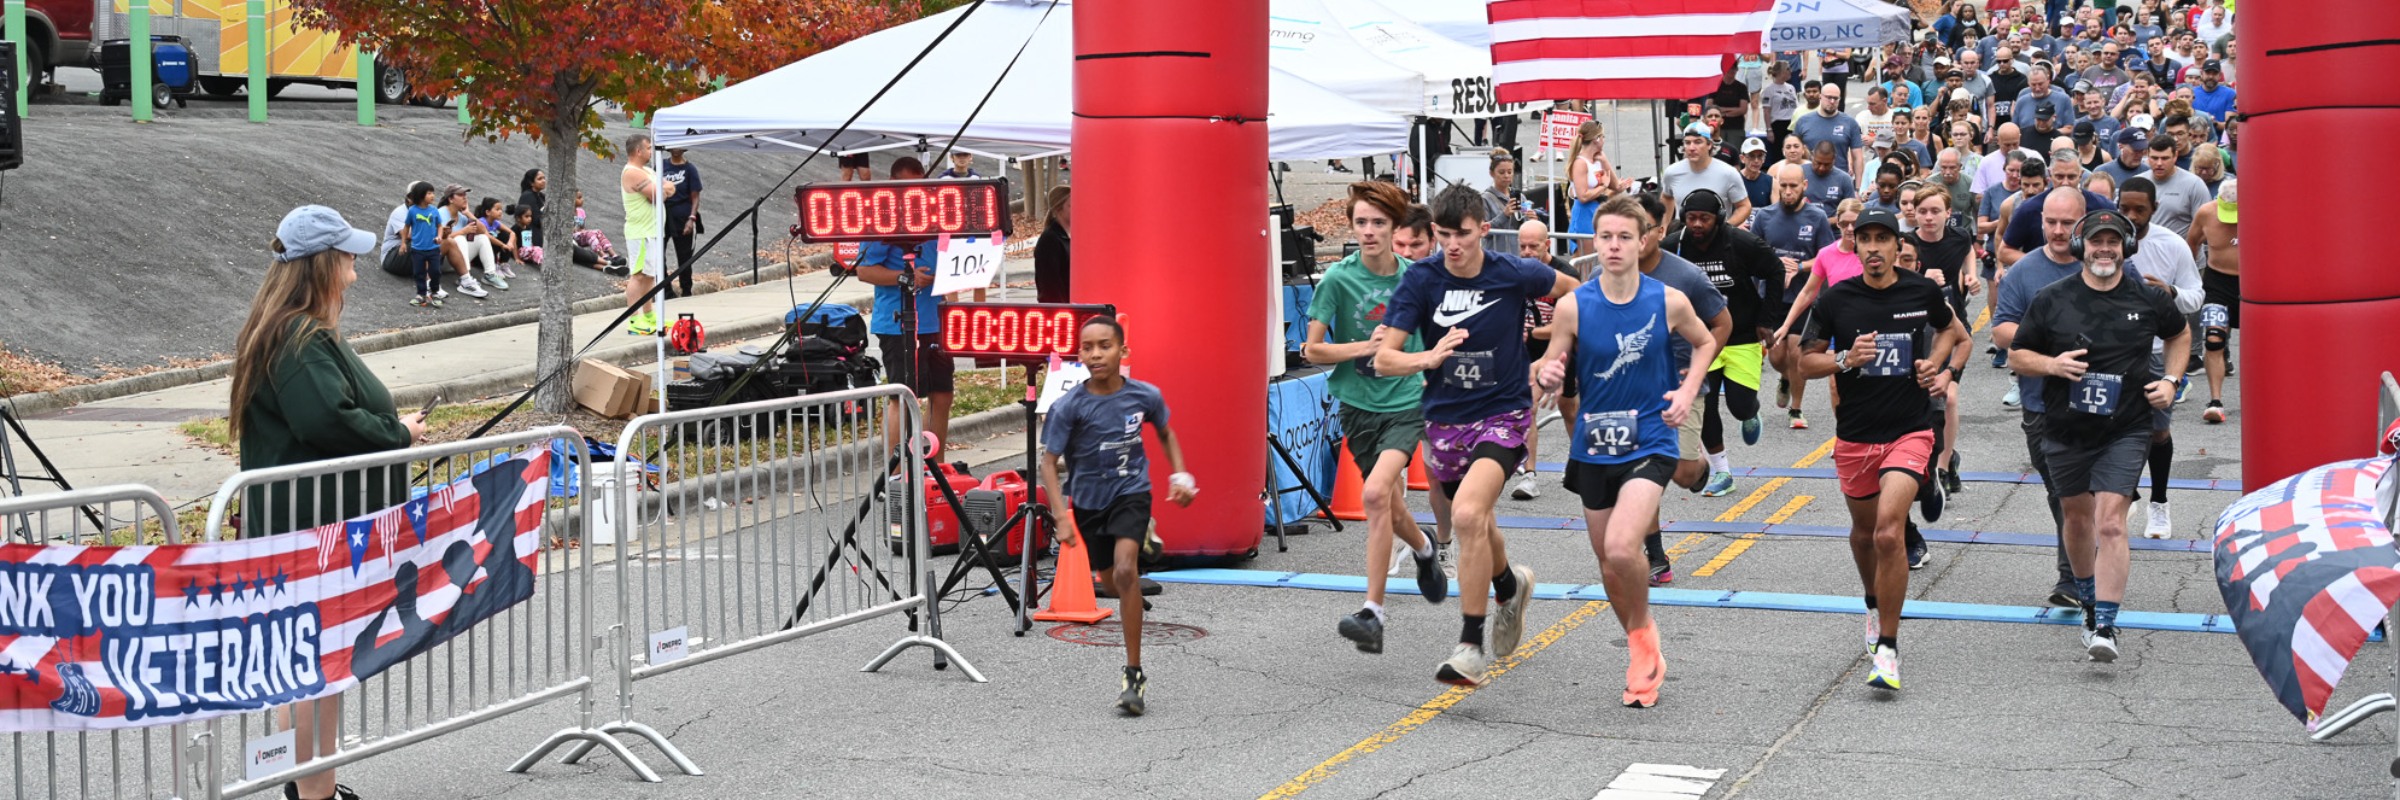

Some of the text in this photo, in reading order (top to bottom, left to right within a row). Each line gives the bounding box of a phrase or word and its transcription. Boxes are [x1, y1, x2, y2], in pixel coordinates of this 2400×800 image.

[1837, 24, 1864, 38] NC
[809, 186, 995, 235] 00:00:01
[950, 253, 990, 277] 10k
[1441, 290, 1485, 312] NIKE
[1893, 310, 1928, 319] MARINES
[2202, 310, 2226, 322] 150
[947, 309, 1075, 353] 00:00:0
[1874, 348, 1900, 367] 74
[1454, 364, 1481, 380] 44
[2082, 386, 2107, 406] 15
[1590, 426, 1631, 446] 142
[1116, 454, 1129, 470] 2
[71, 573, 149, 627] YOU
[108, 612, 318, 710] VETERANS
